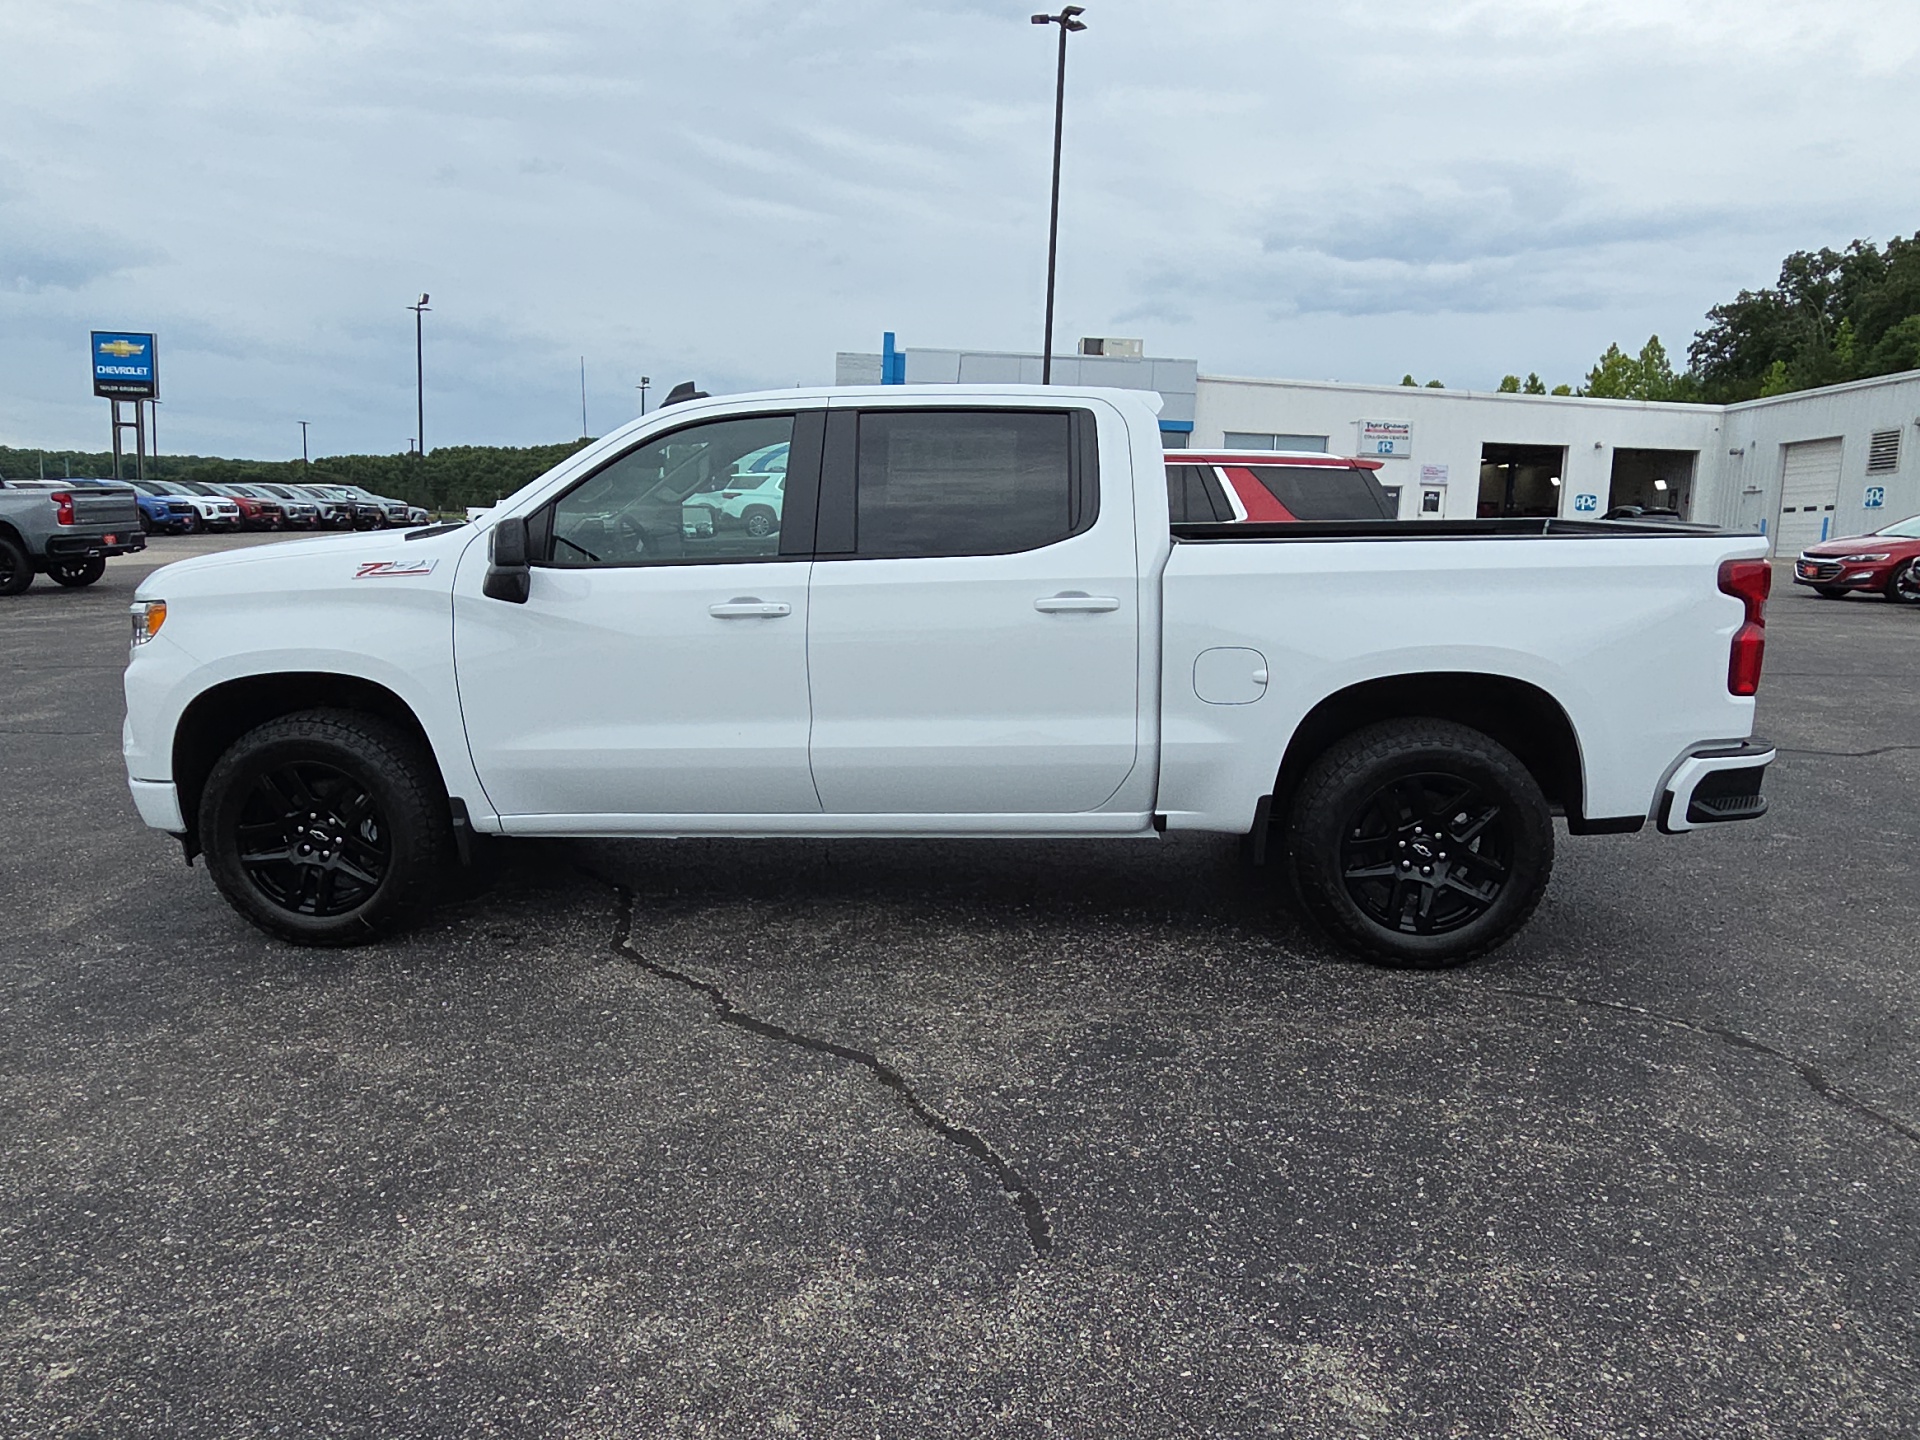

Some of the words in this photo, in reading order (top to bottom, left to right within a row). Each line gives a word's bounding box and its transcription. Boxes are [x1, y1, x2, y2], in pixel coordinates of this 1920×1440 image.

[97, 365, 149, 375] CHEVROLET
[1576, 495, 1596, 510] PPG
[1865, 488, 1884, 506] PPG
